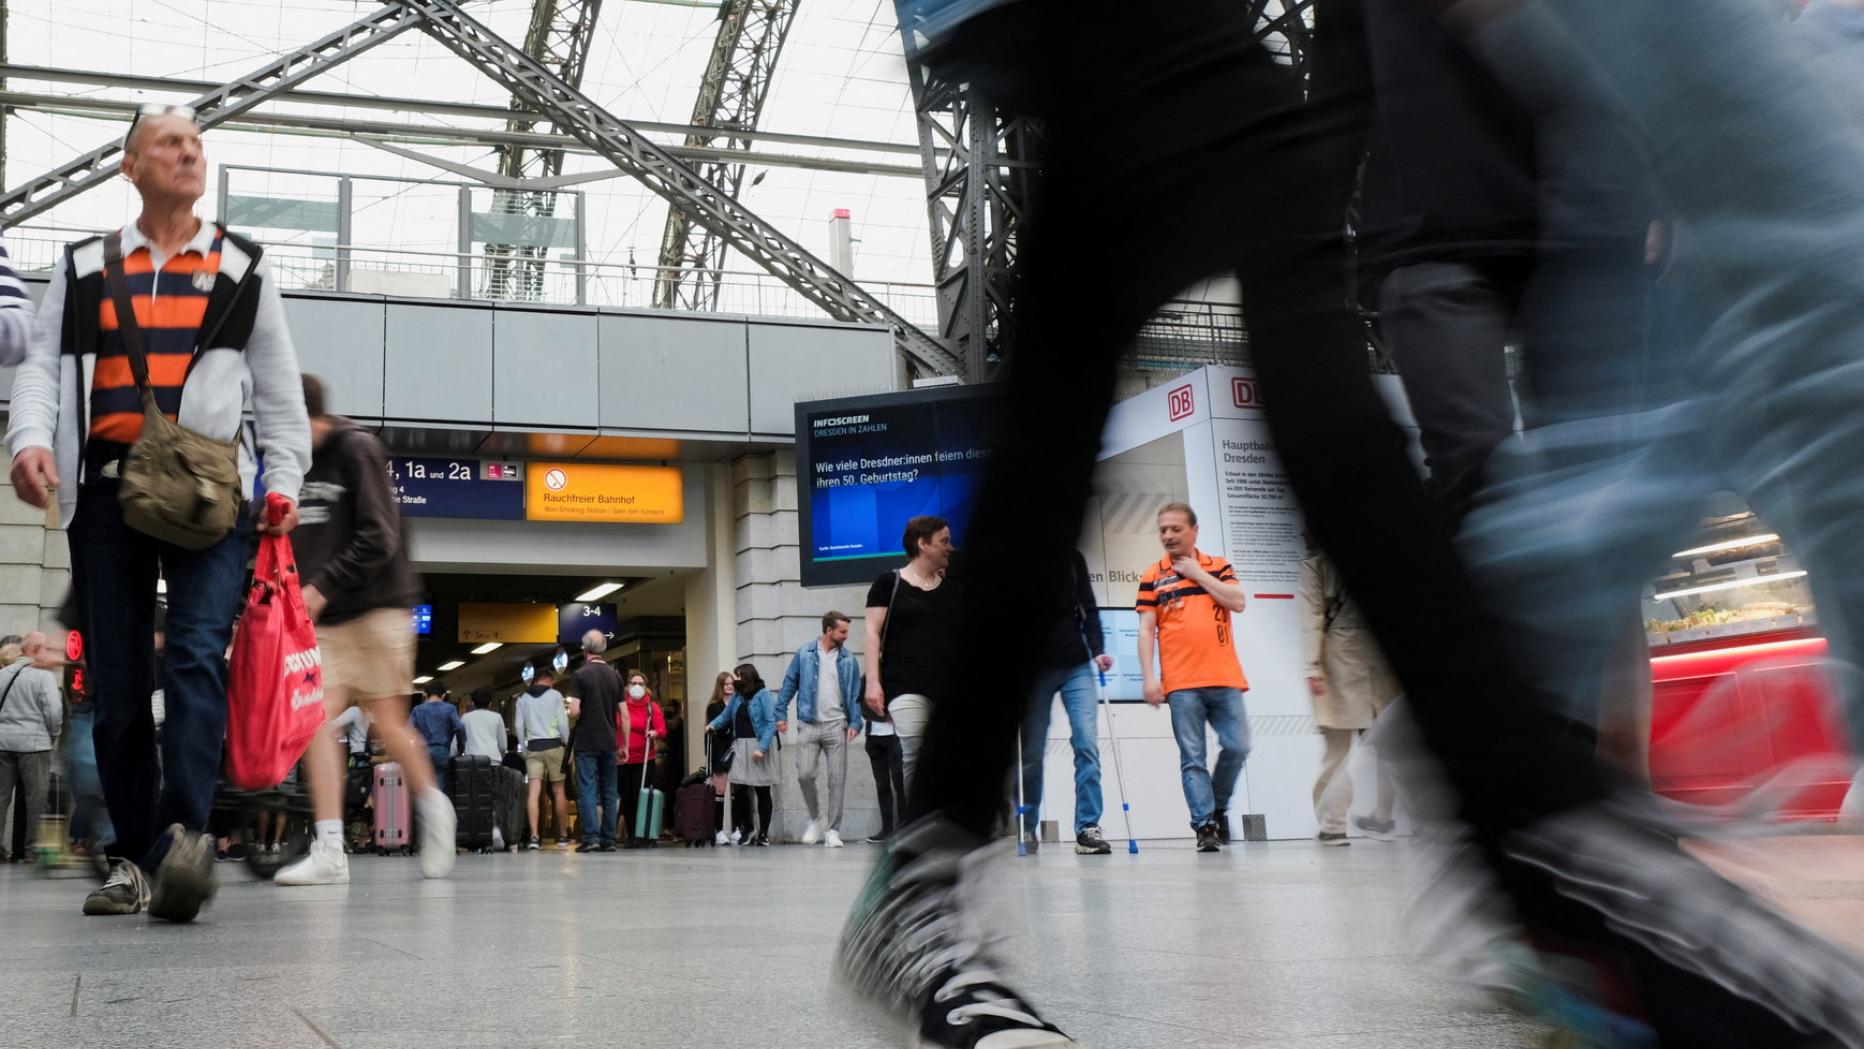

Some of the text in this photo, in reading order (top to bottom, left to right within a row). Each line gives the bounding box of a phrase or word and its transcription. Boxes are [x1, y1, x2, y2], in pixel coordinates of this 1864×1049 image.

[1171, 391, 1191, 416] DB
[814, 415, 869, 427] INFOSCREEN
[814, 423, 887, 438] DRESDEN IN ZAHLEN
[816, 461, 834, 473] Wie
[835, 460, 858, 472] viele
[860, 454, 932, 469] Dresdner:innen
[934, 451, 964, 463] feiern
[1224, 453, 1265, 464] Dresden
[405, 461, 426, 478] 1a
[429, 471, 445, 480] und
[448, 462, 472, 480] 2a
[816, 469, 919, 488] ihren 50. Geburtstag?
[399, 485, 405, 493] 4
[402, 495, 427, 504] Straße
[543, 493, 635, 505] Rauchfreier Bahnhof
[1088, 573, 1104, 582] en
[583, 605, 601, 617] 3-4
